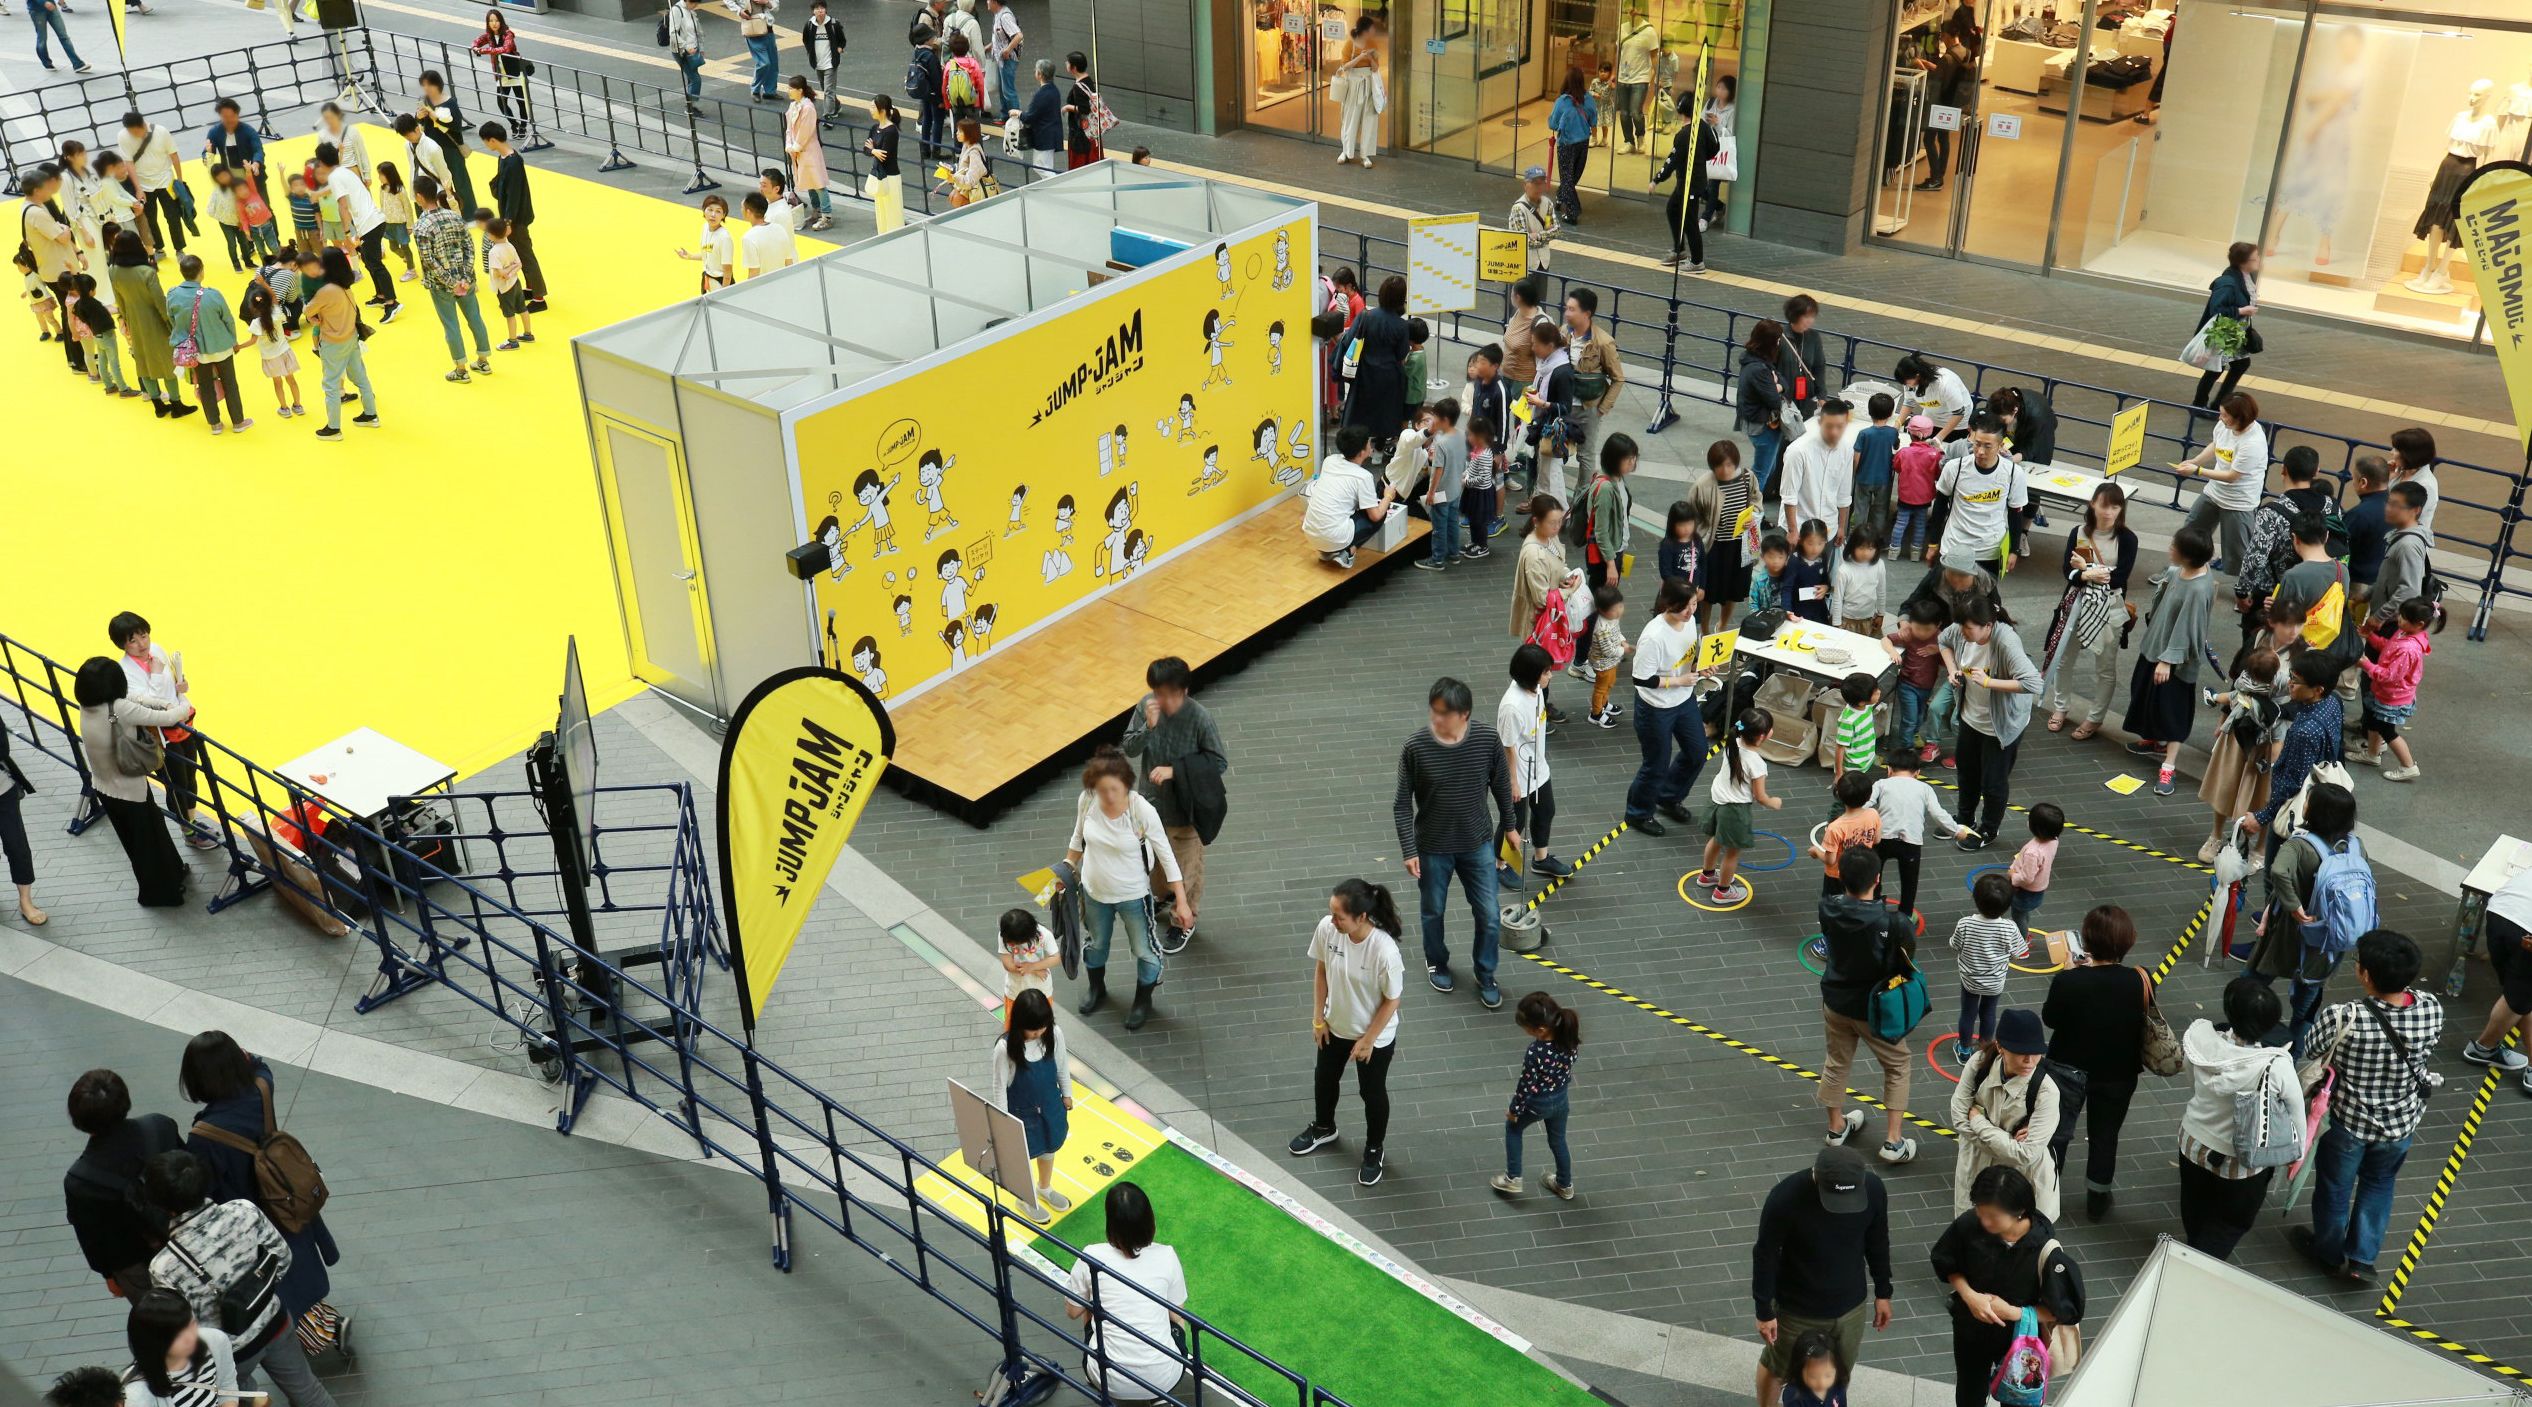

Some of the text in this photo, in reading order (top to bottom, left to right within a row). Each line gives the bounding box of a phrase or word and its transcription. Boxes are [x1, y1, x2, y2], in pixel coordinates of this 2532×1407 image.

[1045, 307, 1143, 417] JUMP-JAM
[1095, 355, 1144, 395] ジャンジャン
[830, 749, 874, 820] ジャンジャン
